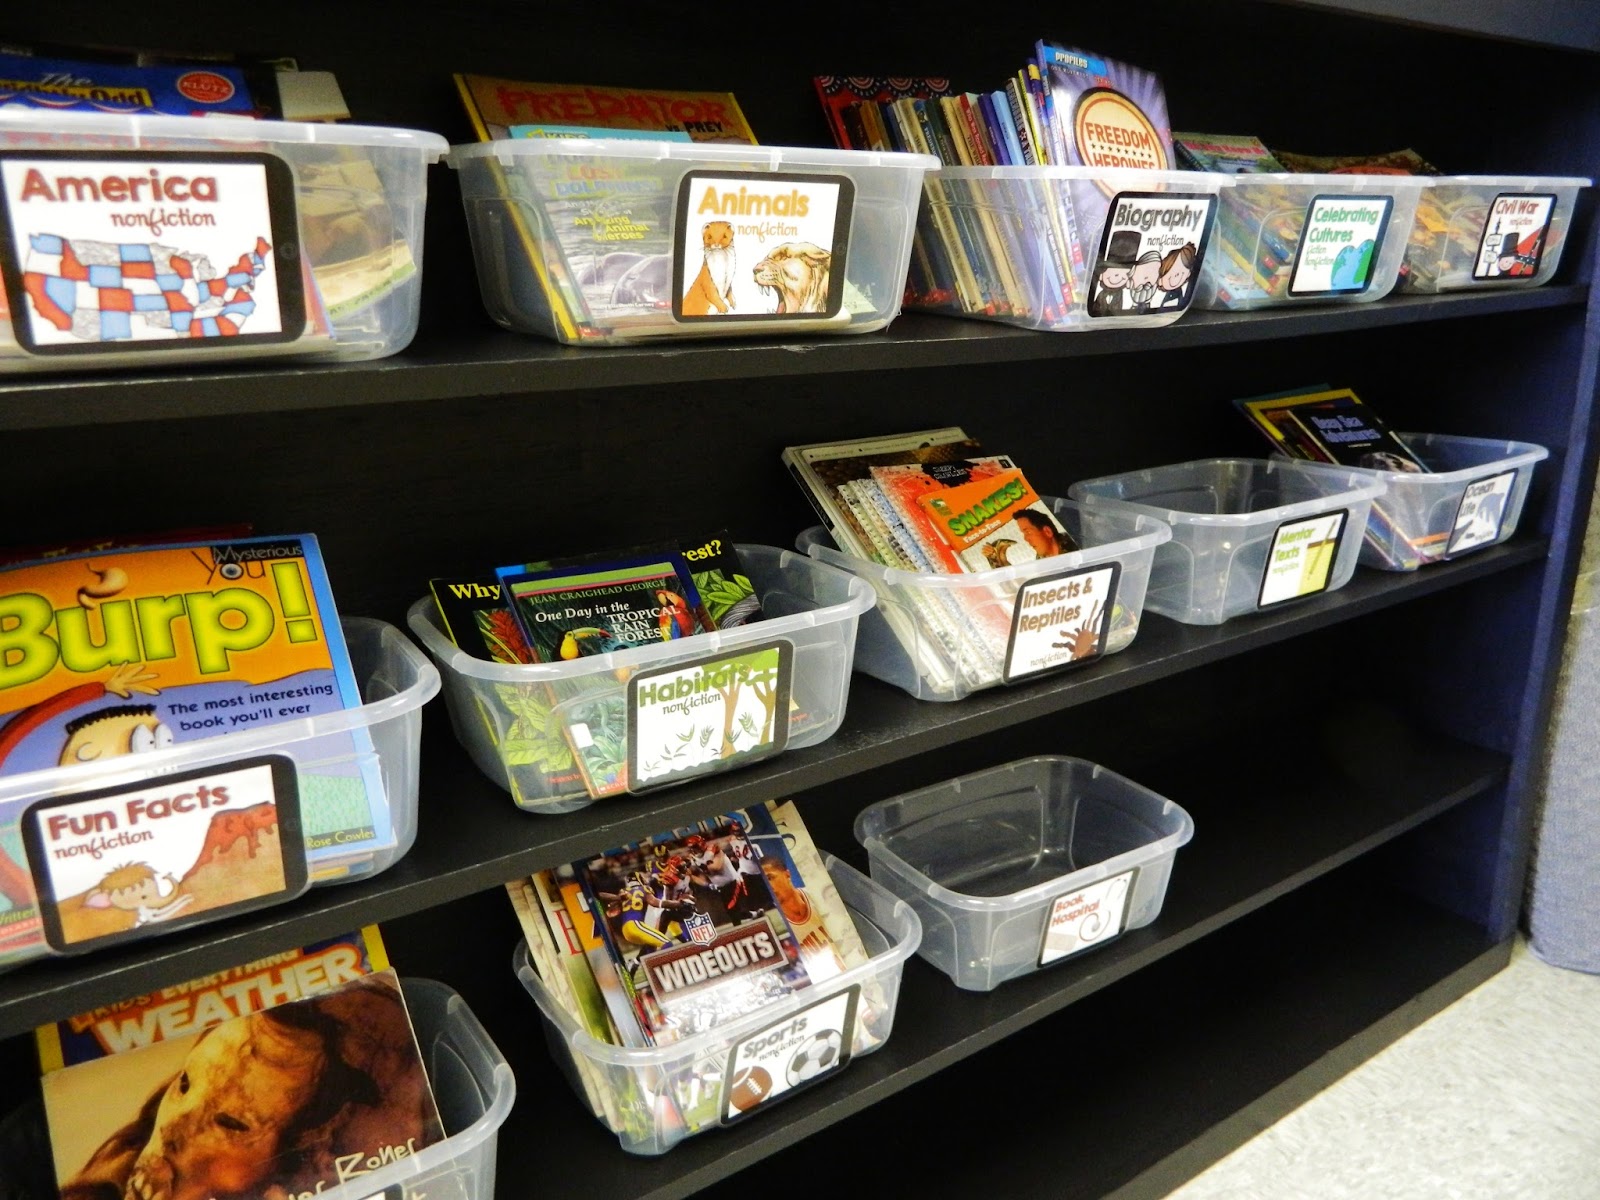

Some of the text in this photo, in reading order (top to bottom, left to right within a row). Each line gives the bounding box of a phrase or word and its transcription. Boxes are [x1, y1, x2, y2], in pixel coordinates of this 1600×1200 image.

[182, 81, 230, 94] KLUTZ
[497, 85, 735, 127] PREDATOR
[686, 121, 723, 133] PREY
[1085, 122, 1152, 150] FREEDOM
[20, 168, 220, 202] America
[698, 186, 810, 217] Animals
[1496, 200, 1539, 214] Civil War
[111, 209, 216, 236] nonfiction
[1114, 204, 1203, 232] Biography
[1315, 207, 1379, 225] Celebrating
[606, 224, 650, 233] Animal
[737, 221, 798, 243] nonfiction
[1309, 227, 1354, 242] Cultures
[1146, 235, 1184, 251] nonfiction
[1467, 482, 1496, 498] Ocean
[948, 477, 1028, 536] SNAKES!
[1279, 528, 1316, 544] Mentor
[213, 545, 304, 563] Mysterious
[1276, 547, 1300, 561] Texts
[448, 583, 500, 600] Why
[530, 579, 666, 606] JEAN CRAIGHEAD GEORGE
[1023, 577, 1092, 609] Insects &
[535, 601, 630, 623] One Day in the
[606, 604, 681, 625] TROPICAL
[1019, 605, 1082, 633] Reptiles
[0, 561, 318, 691] Burp!
[612, 620, 650, 634] RAIN
[616, 626, 671, 644] FOREST
[1030, 651, 1068, 668] nonfiction
[639, 663, 750, 707] Habitats
[168, 683, 333, 716] The most interesting
[662, 693, 721, 716] nonfiction
[180, 704, 311, 731] book you'll ever
[48, 785, 231, 841] Fun Facts
[55, 829, 154, 860] nonfiction
[306, 828, 374, 849] Rose Cowles
[1051, 901, 1100, 927] Hospital
[1055, 894, 1086, 913] Book
[691, 927, 713, 941] NFL
[653, 931, 774, 992] WIDEOUTS
[97, 949, 361, 1054] WEATHER
[758, 1035, 805, 1060] nonfiction
